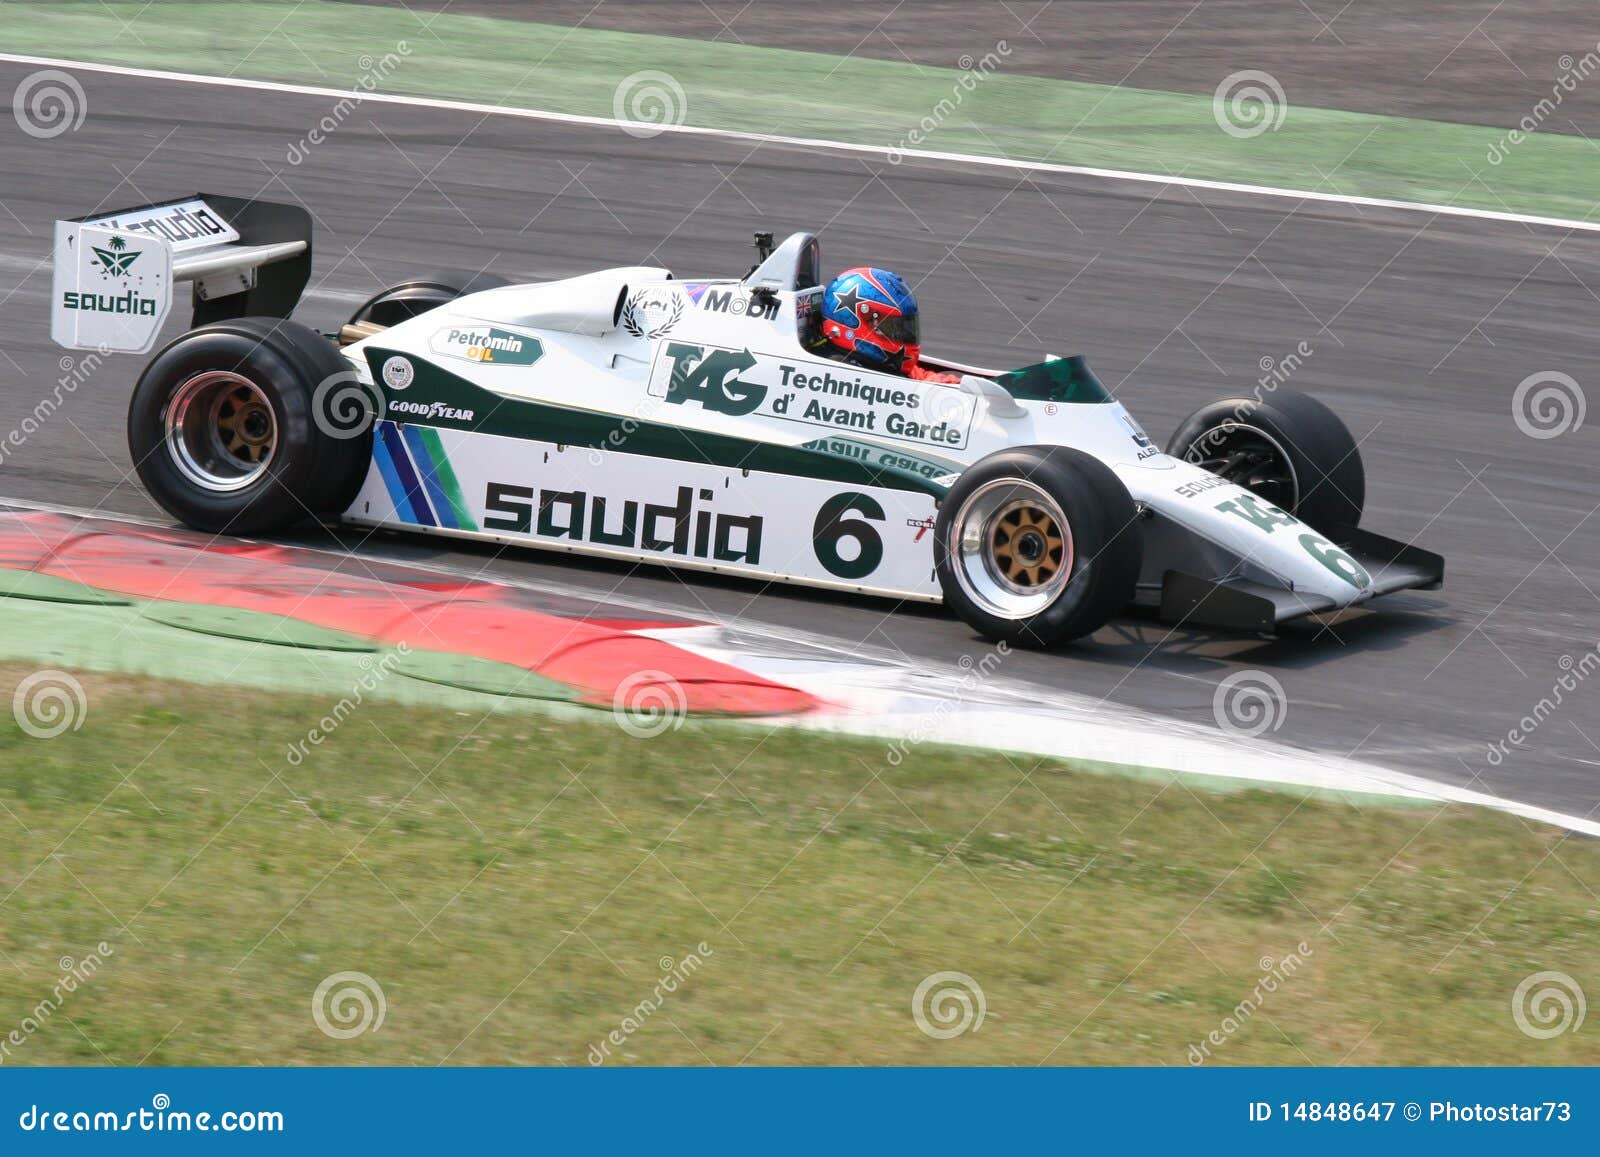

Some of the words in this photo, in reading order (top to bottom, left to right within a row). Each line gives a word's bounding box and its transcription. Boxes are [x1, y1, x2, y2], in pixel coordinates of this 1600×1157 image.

[64, 290, 156, 316] saudia
[447, 330, 523, 352] Petromin
[664, 342, 768, 416] TAG
[778, 365, 921, 409] Techniques
[388, 400, 475, 421] GOODYEAR
[803, 399, 876, 430] Avant
[885, 413, 962, 444] Garde
[483, 482, 764, 566] saudia
[812, 491, 886, 580] 6
[1298, 533, 1370, 590] 6
